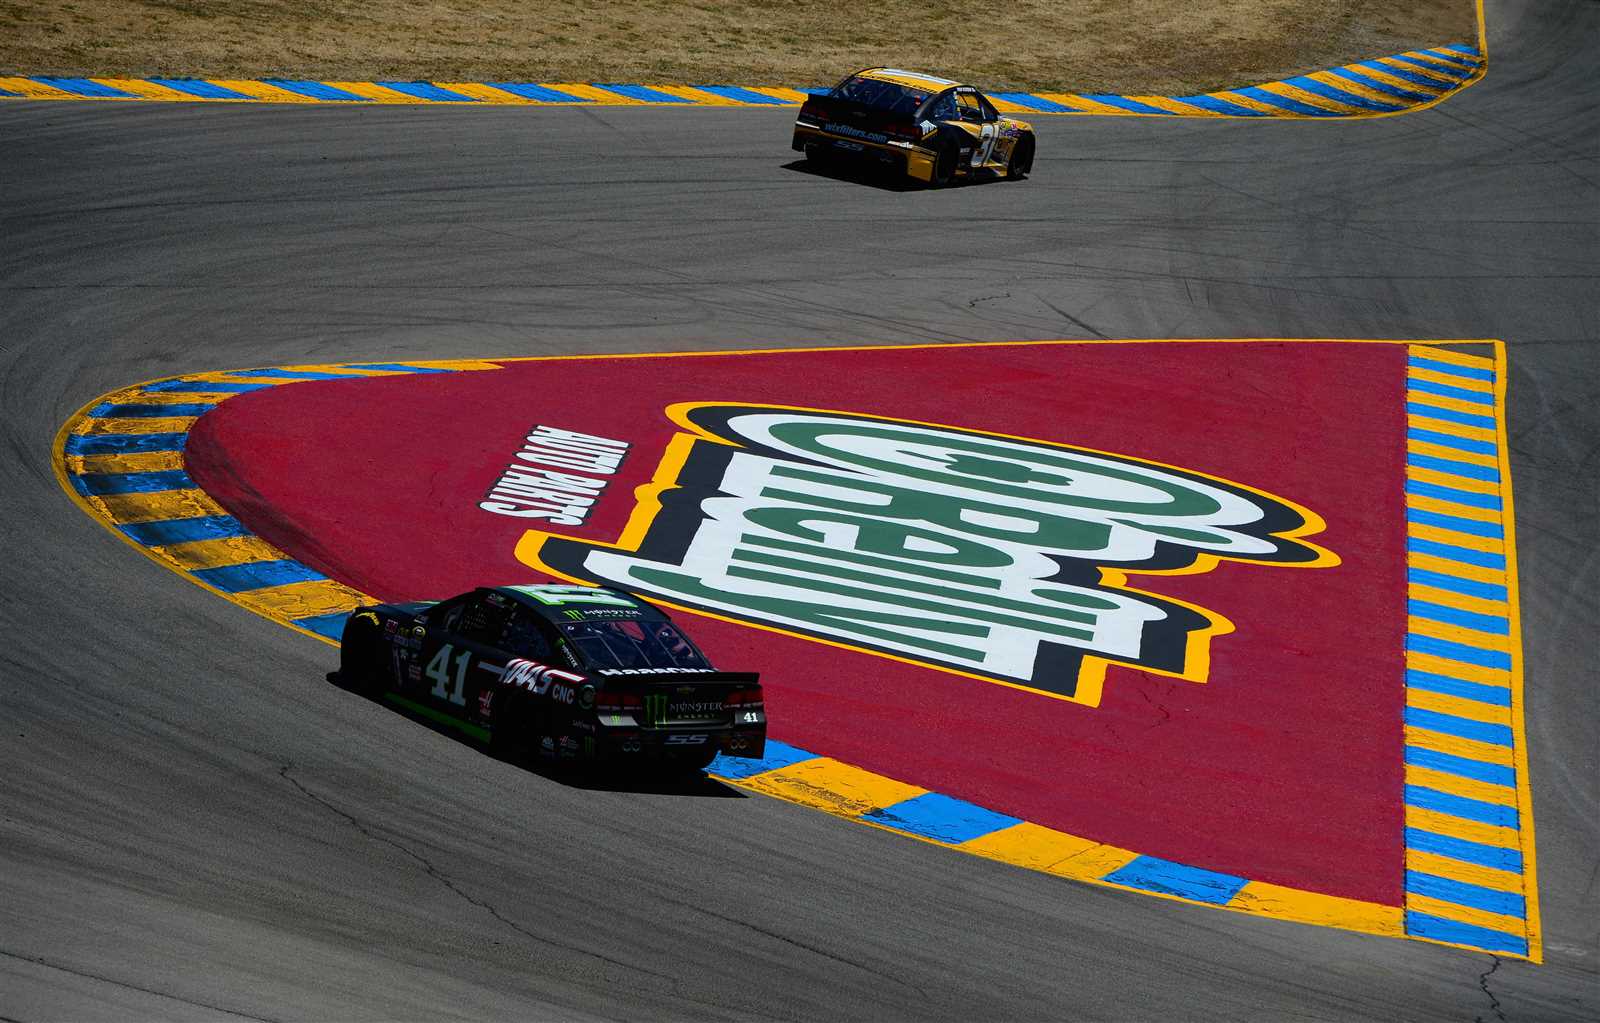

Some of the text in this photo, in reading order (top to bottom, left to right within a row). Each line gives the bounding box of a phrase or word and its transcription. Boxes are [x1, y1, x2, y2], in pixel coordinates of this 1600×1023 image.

[477, 424, 629, 527] AUTO PARTS
[425, 642, 473, 707] 41
[551, 683, 577, 705] CNC
[669, 702, 723, 713] MONSTER
[742, 711, 758, 723] 41
[662, 732, 710, 746] SS
